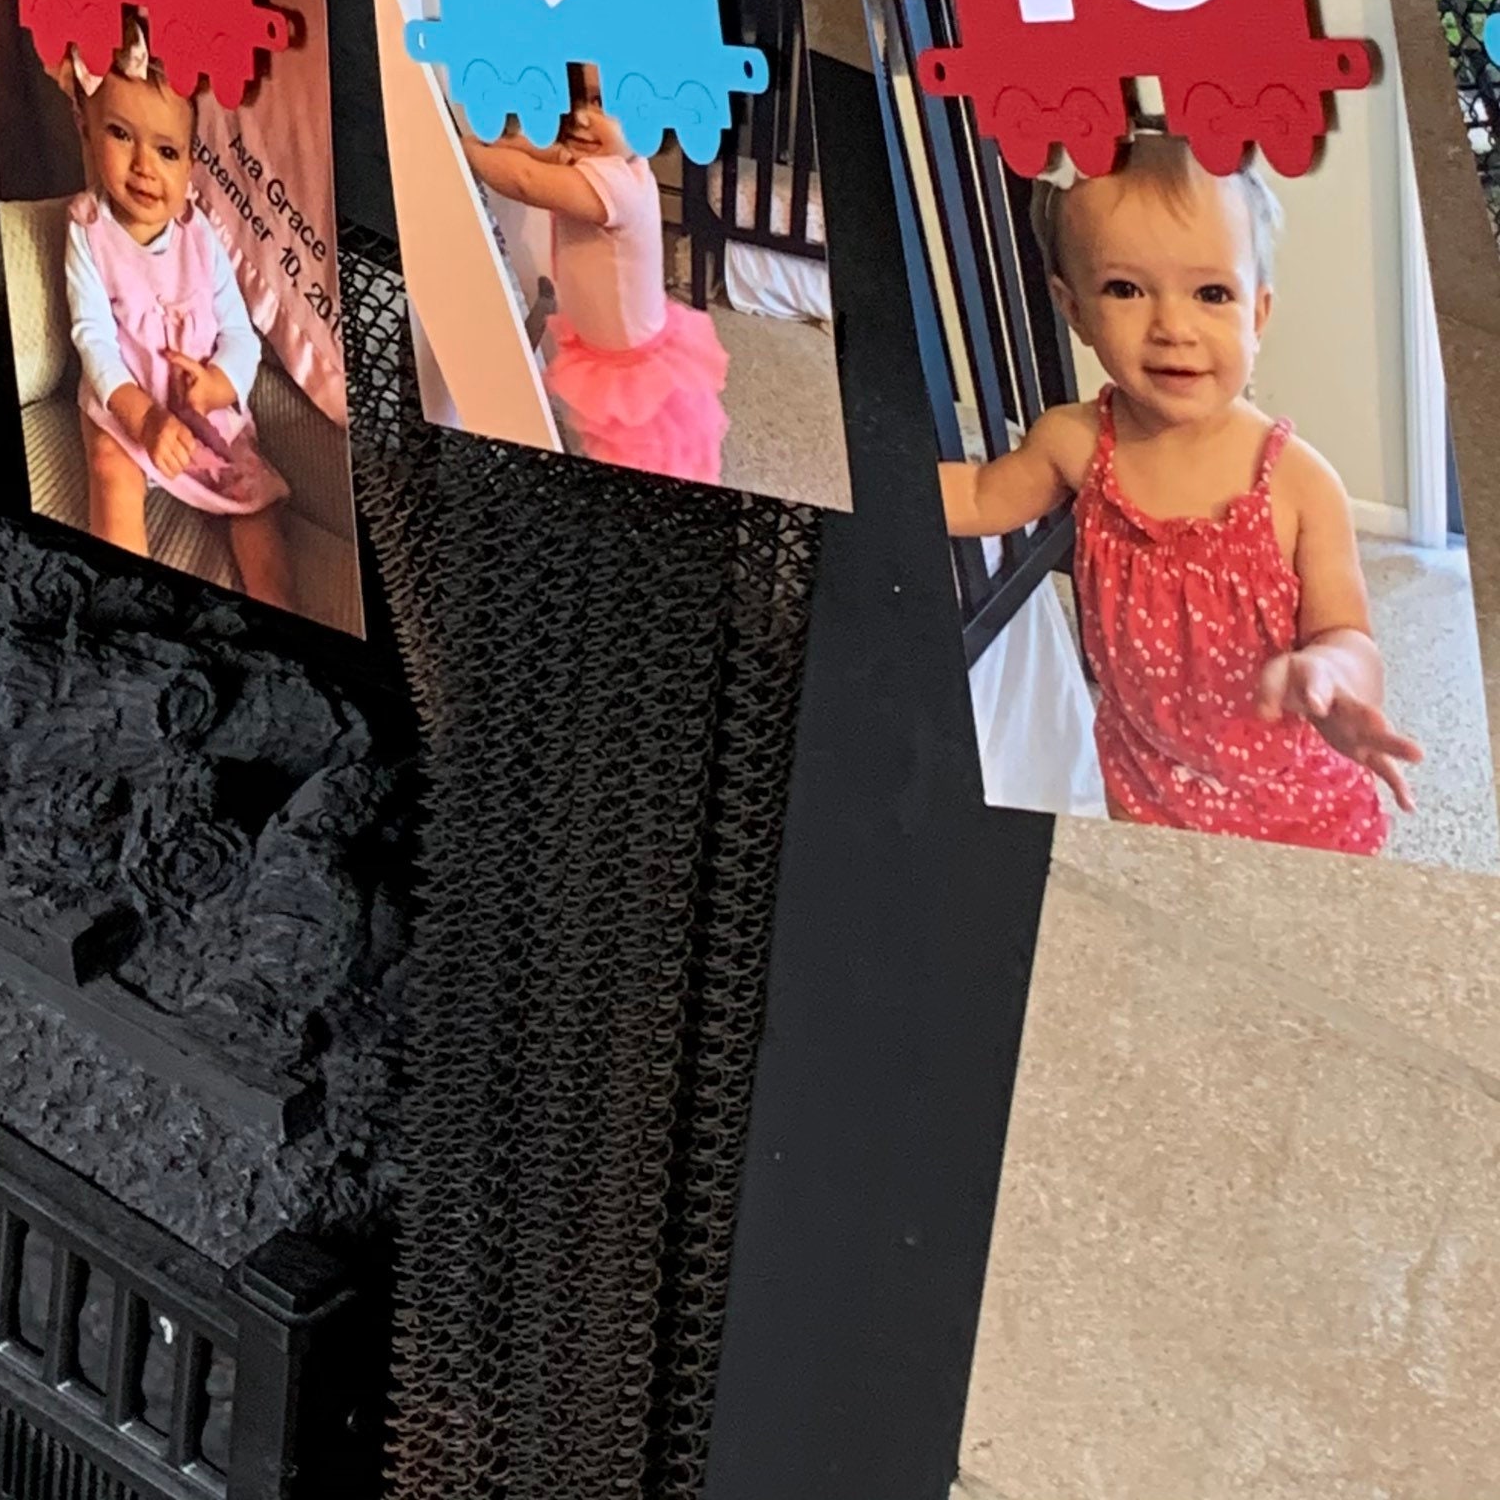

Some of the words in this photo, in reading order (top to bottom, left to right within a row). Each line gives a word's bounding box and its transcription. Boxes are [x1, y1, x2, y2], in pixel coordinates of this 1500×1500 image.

[190, 133, 275, 243] eptember
[278, 245, 302, 288] 10,
[229, 132, 263, 182] Ava
[266, 177, 327, 263] Grace
